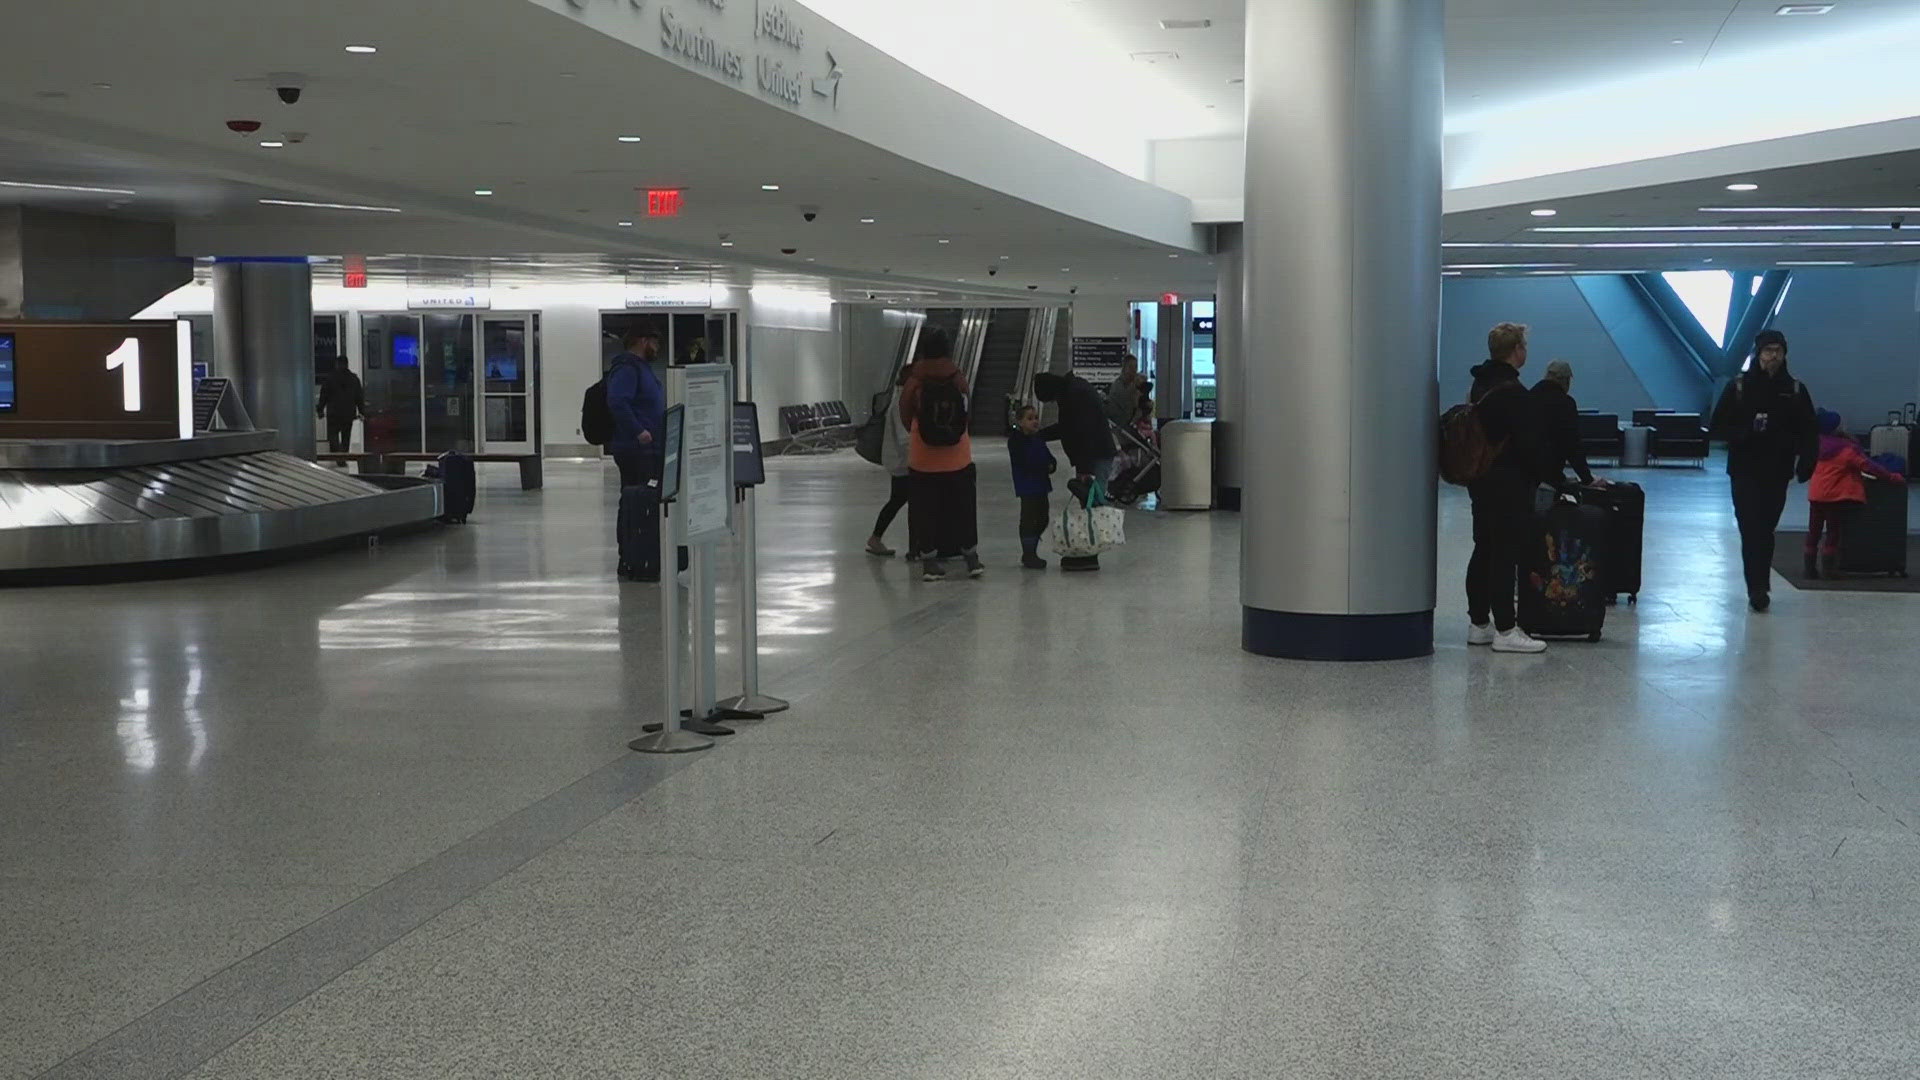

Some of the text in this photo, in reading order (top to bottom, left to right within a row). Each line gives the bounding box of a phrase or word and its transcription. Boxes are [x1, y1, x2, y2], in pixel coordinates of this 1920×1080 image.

[756, 55, 803, 104] United
[648, 190, 678, 216] EXIT
[105, 337, 141, 412] 1
